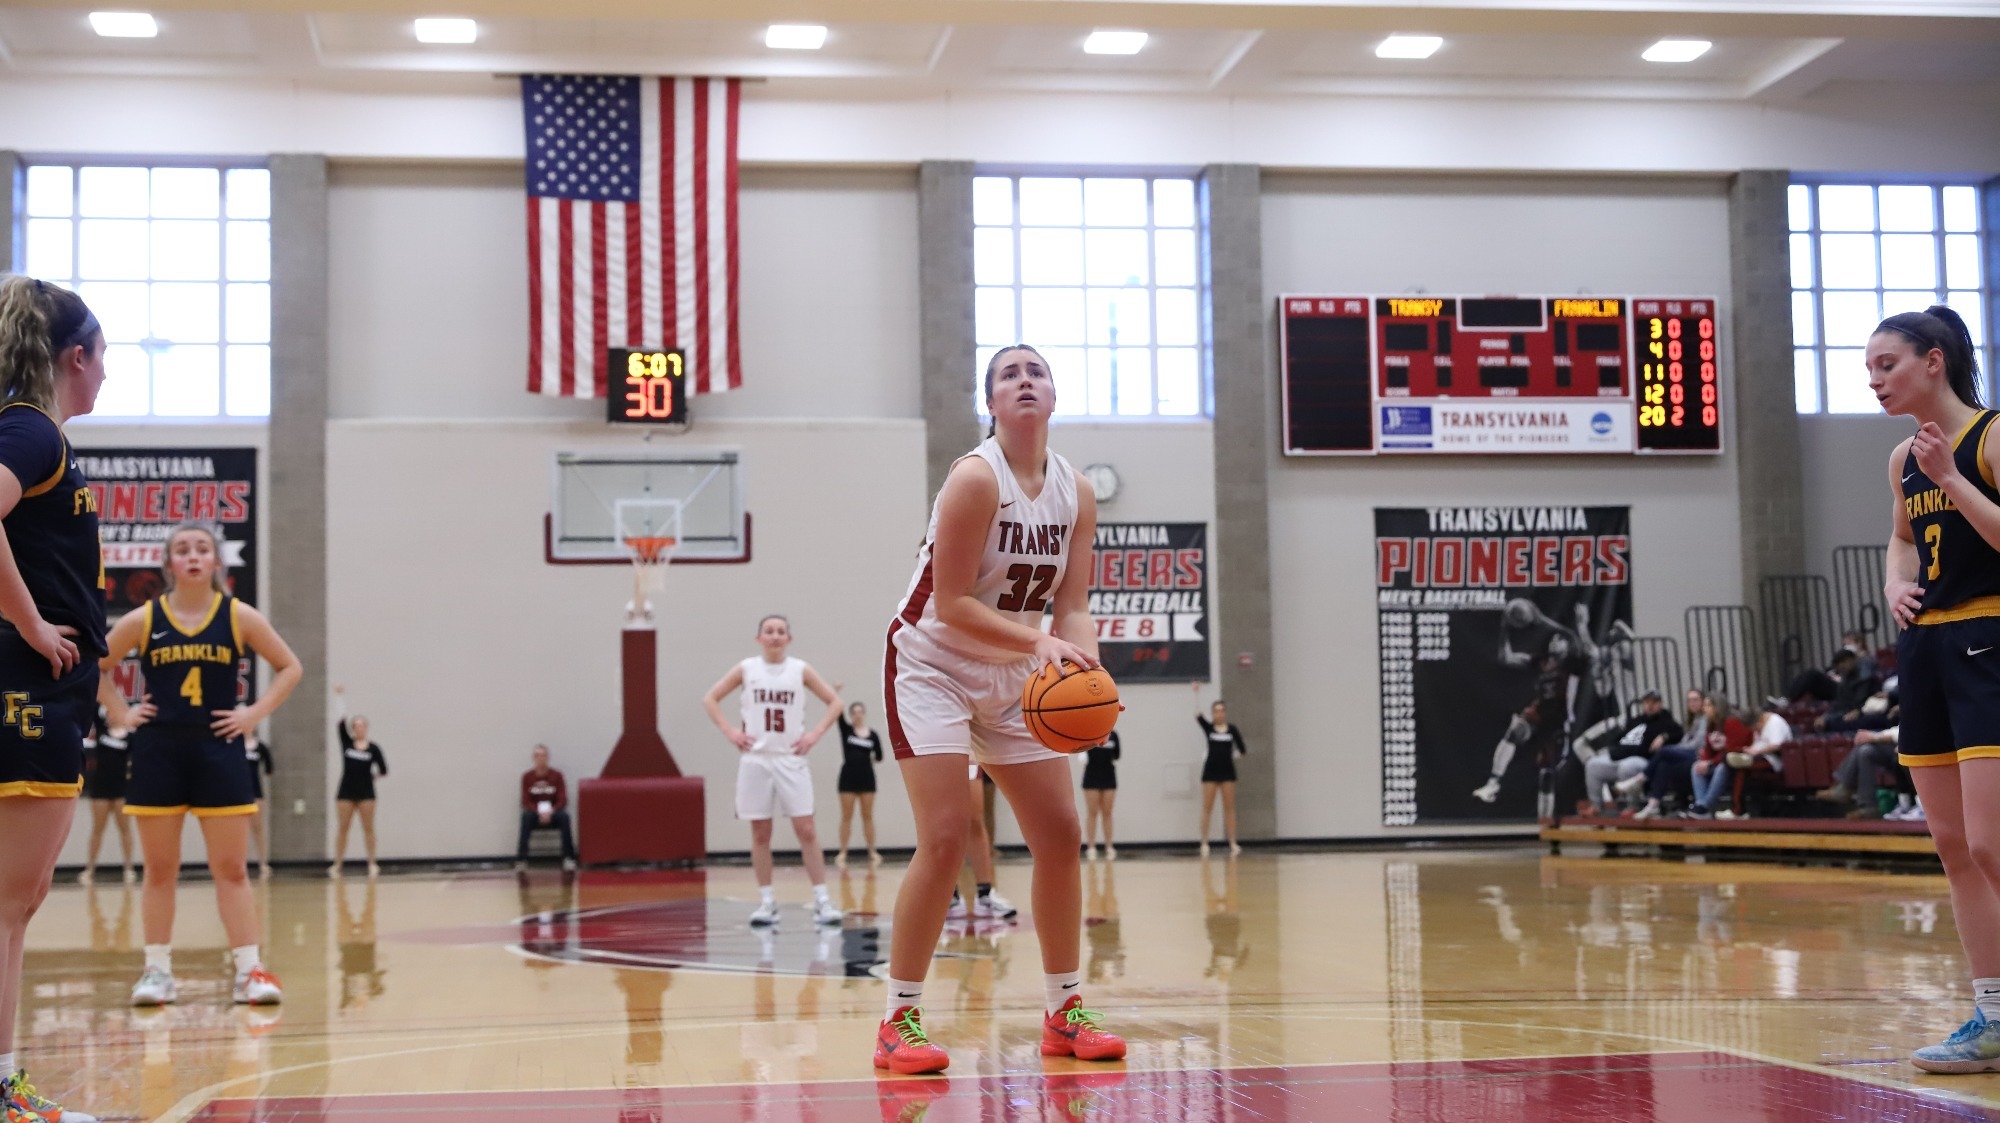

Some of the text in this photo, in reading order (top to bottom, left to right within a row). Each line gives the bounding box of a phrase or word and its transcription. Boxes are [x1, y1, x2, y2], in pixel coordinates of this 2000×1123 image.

[1388, 299, 1443, 316] TRANSY
[1553, 299, 1619, 317] FRANKLIN
[1650, 318, 1713, 339] 3 0 0
[1649, 340, 1714, 361] 4 0 0
[628, 352, 682, 377] 6:07
[1643, 362, 1715, 383] 11 0 0
[625, 376, 672, 418] 30
[1645, 384, 1716, 405] 12 0 0
[1441, 412, 1569, 428] TRANSYLVANIA
[1639, 405, 1666, 427] 20
[1671, 405, 1685, 427] 2
[1703, 405, 1717, 427] 0
[1426, 507, 1587, 532] TRANSYLVANIA
[998, 521, 1068, 556] TRANSY
[1093, 525, 1170, 547] YLVANIA
[1377, 535, 1630, 588] PIONEERS
[1925, 523, 1941, 581] 3
[997, 563, 1058, 612] 32
[1424, 590, 1506, 605] BASKETBALL
[1089, 592, 1203, 613] ASKETBALL
[1137, 618, 1155, 638] 8
[151, 644, 232, 667] FRANKLIN
[180, 666, 203, 706] 4
[752, 689, 795, 705] TRANSY
[765, 708, 785, 732] 15
